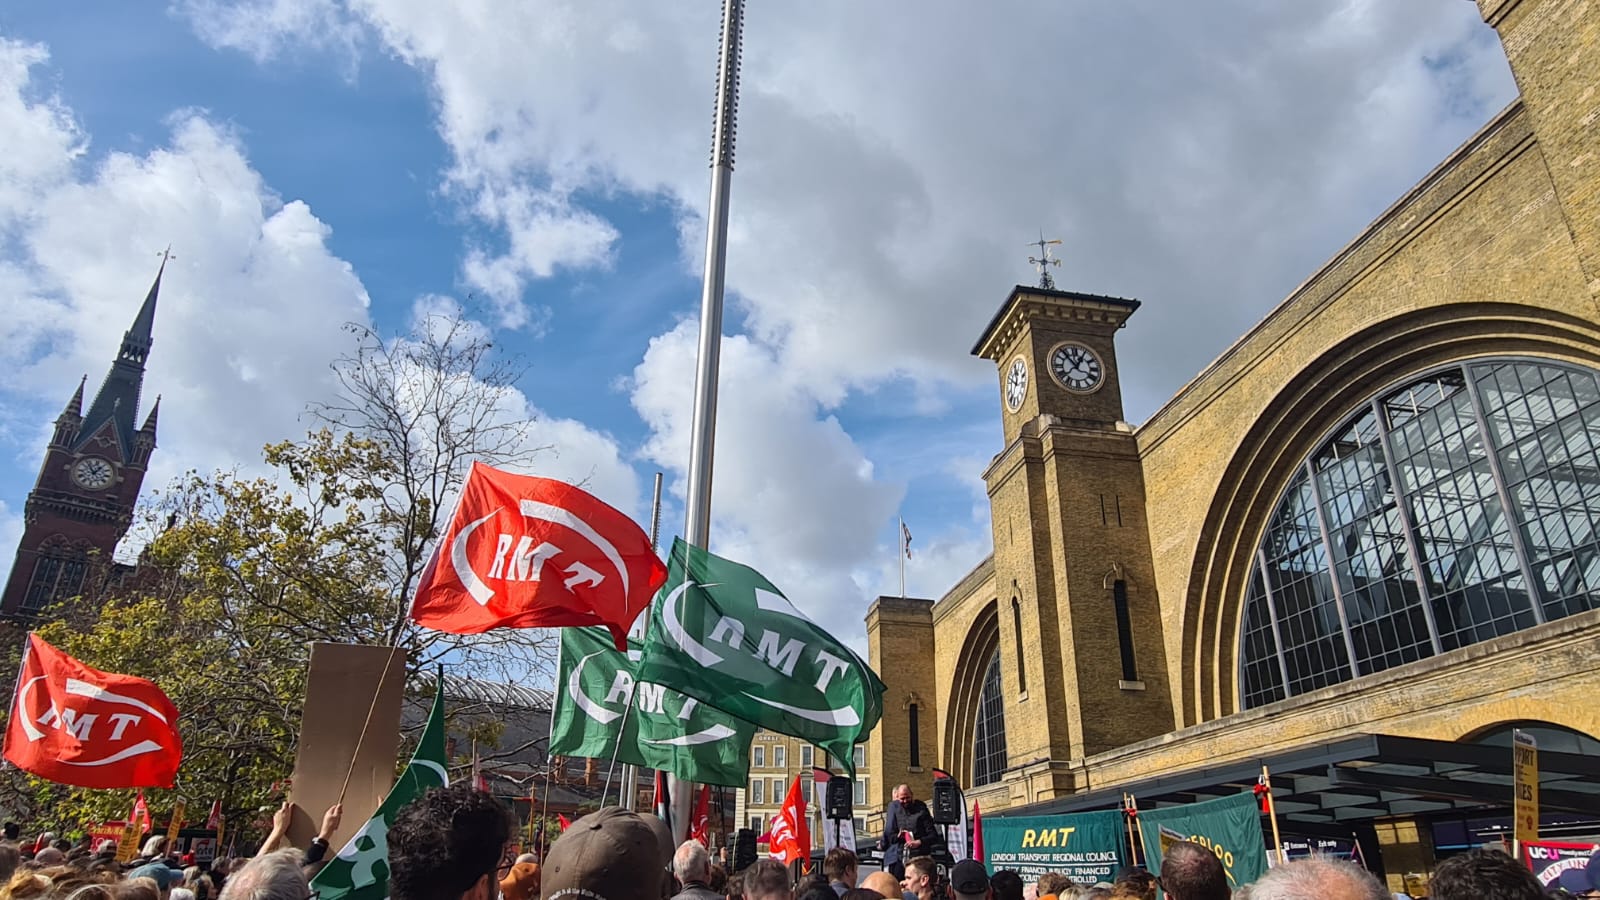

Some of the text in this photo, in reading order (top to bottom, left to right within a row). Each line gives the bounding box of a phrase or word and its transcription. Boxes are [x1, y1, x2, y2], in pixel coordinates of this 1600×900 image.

[487, 533, 605, 595] RMT
[708, 615, 850, 694] RMT
[1022, 827, 1075, 848] RMT
[991, 853, 1016, 861] LONDON
[1018, 853, 1050, 861] TRANSPORT
[1052, 853, 1085, 862] REGIONAL
[1075, 866, 1110, 875] FINANCED
